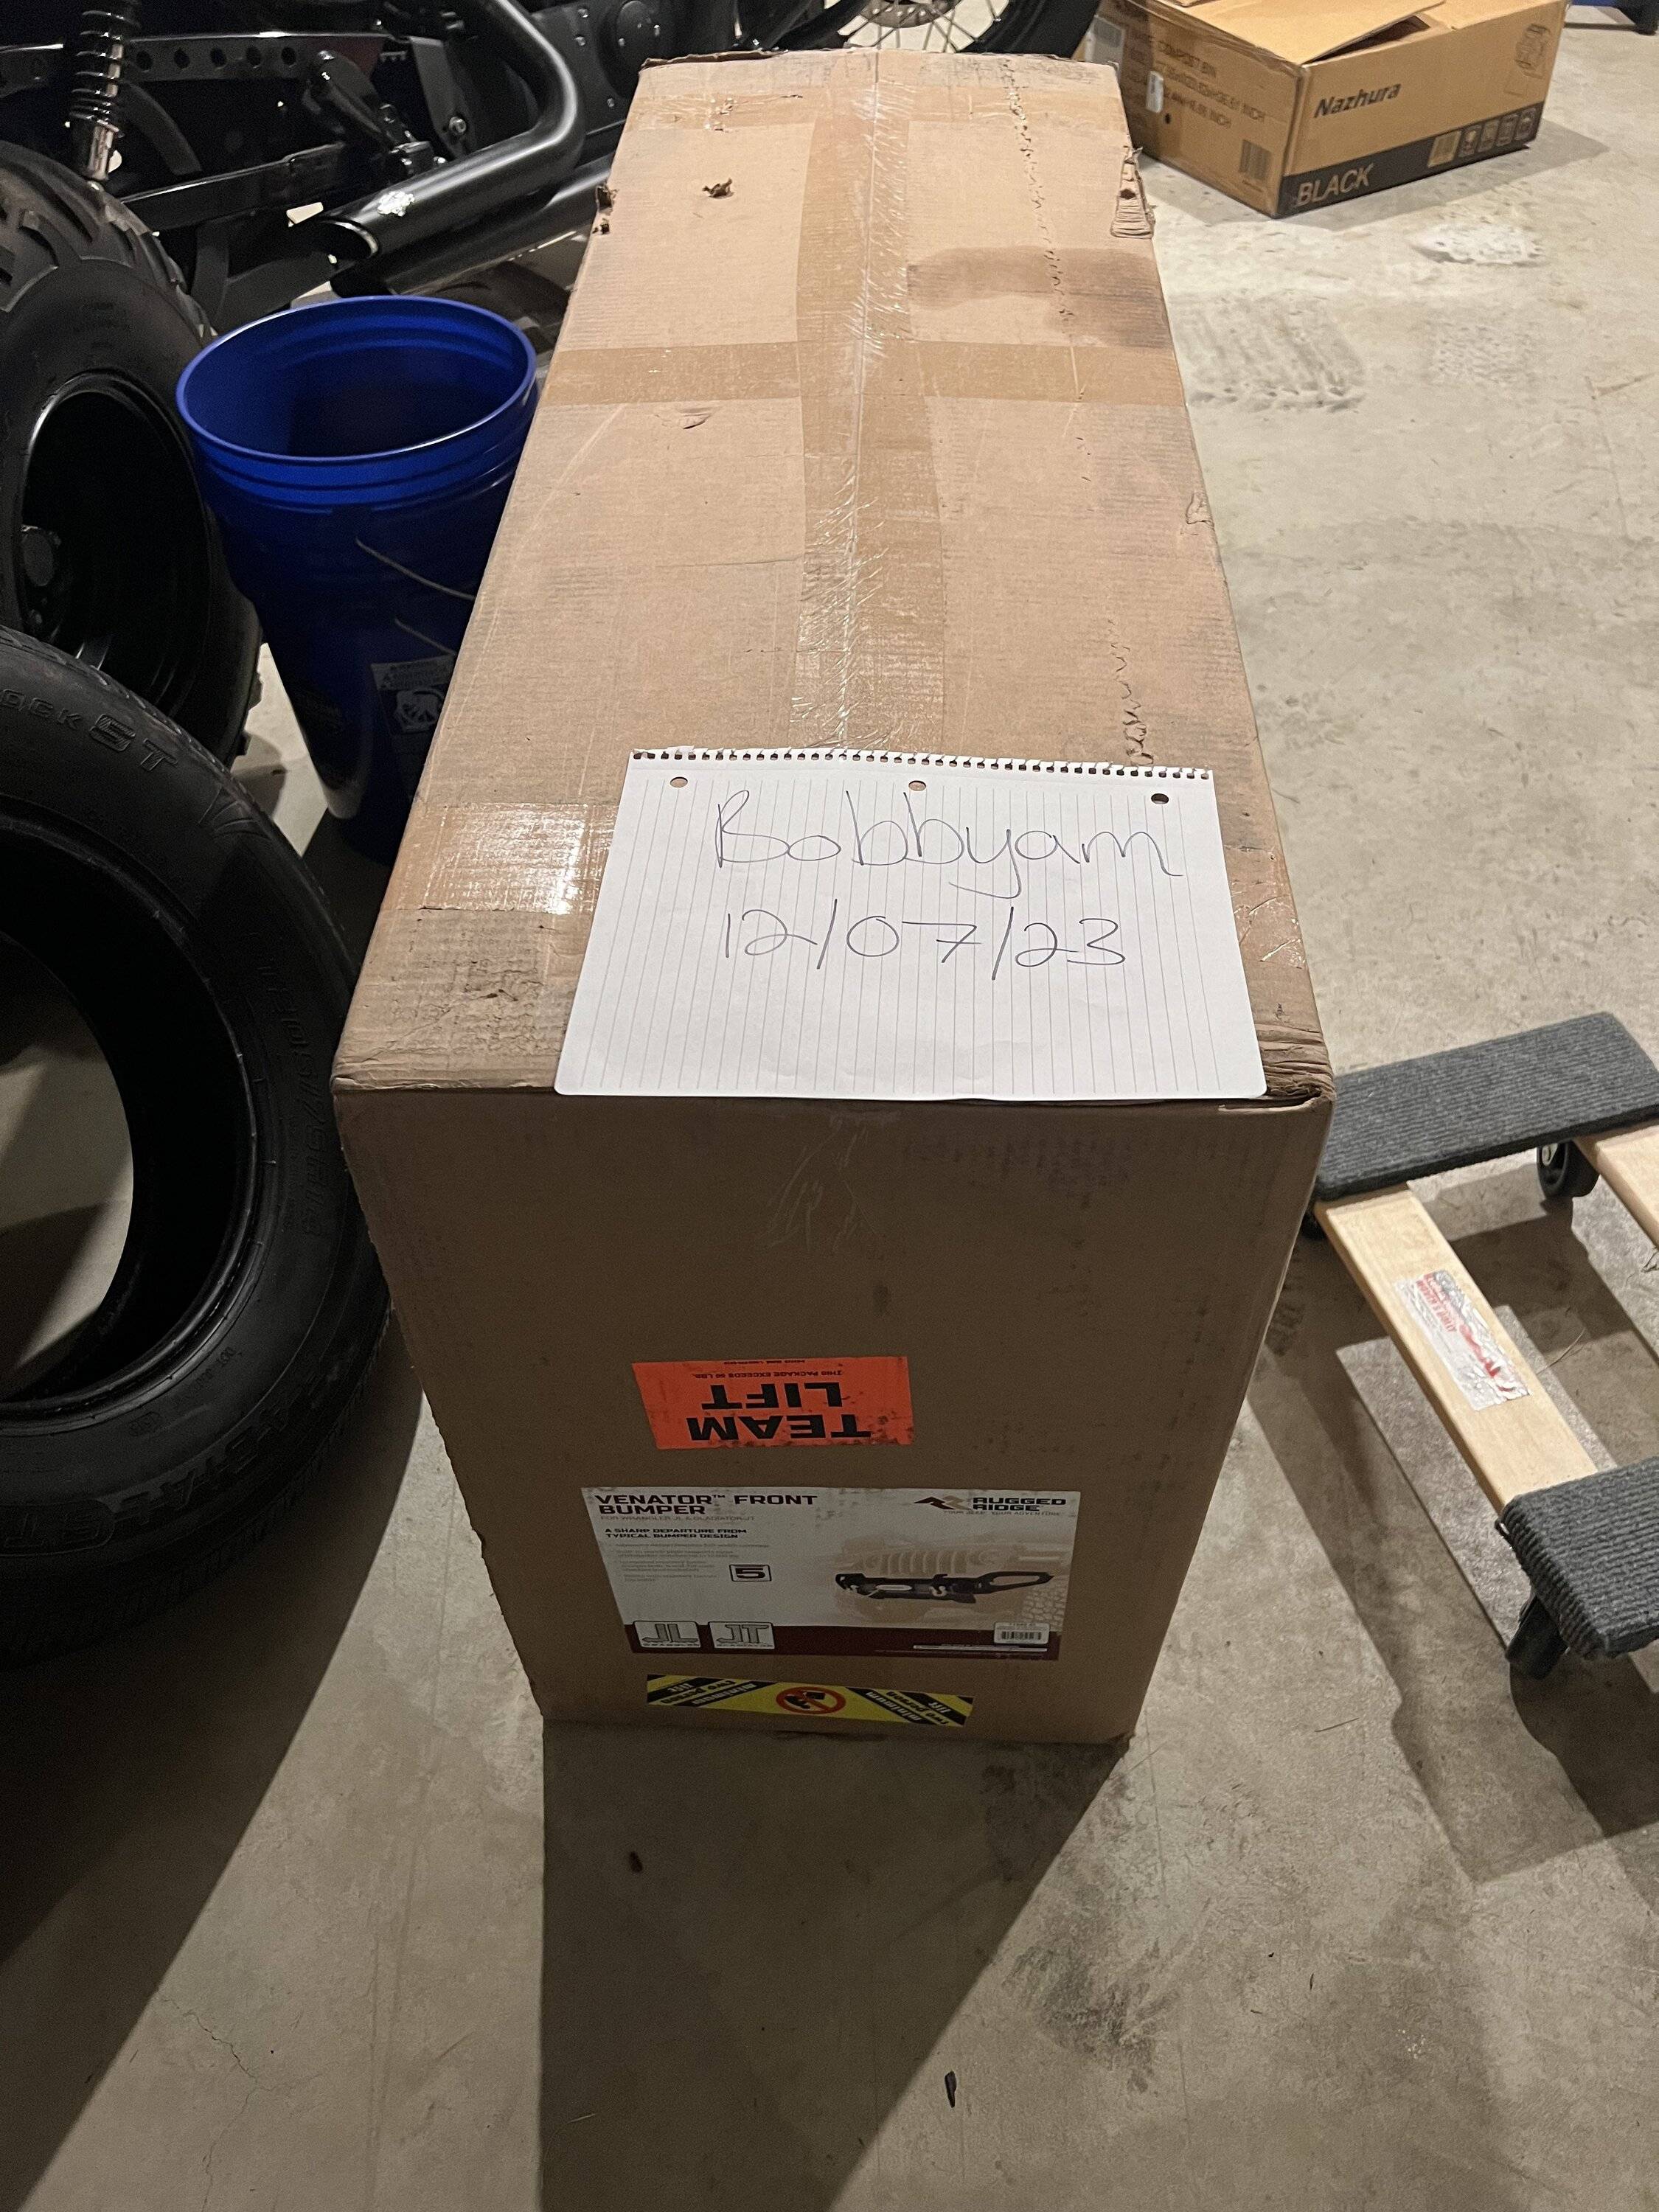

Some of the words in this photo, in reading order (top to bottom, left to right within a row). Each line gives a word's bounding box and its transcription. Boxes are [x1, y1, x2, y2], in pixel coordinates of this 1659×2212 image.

[1313, 83, 1402, 119] Nazhura
[1298, 164, 1374, 206] BLACK
[717, 789, 1183, 898] Bobbyam
[725, 899, 1126, 980] 12/07/23
[701, 1382, 843, 1410] LIFT
[686, 1414, 871, 1441] TEAM
[599, 1505, 706, 1515] BUMPER
[734, 1495, 818, 1505] FRONT
[973, 1497, 1066, 1506] RUGGED
[735, 1567, 765, 1579] 5
[667, 1683, 694, 1693] lift
[691, 1683, 757, 1704] minimum
[865, 1691, 922, 1721] minimum
[886, 1691, 928, 1713] person
[928, 1702, 951, 1714] lift
